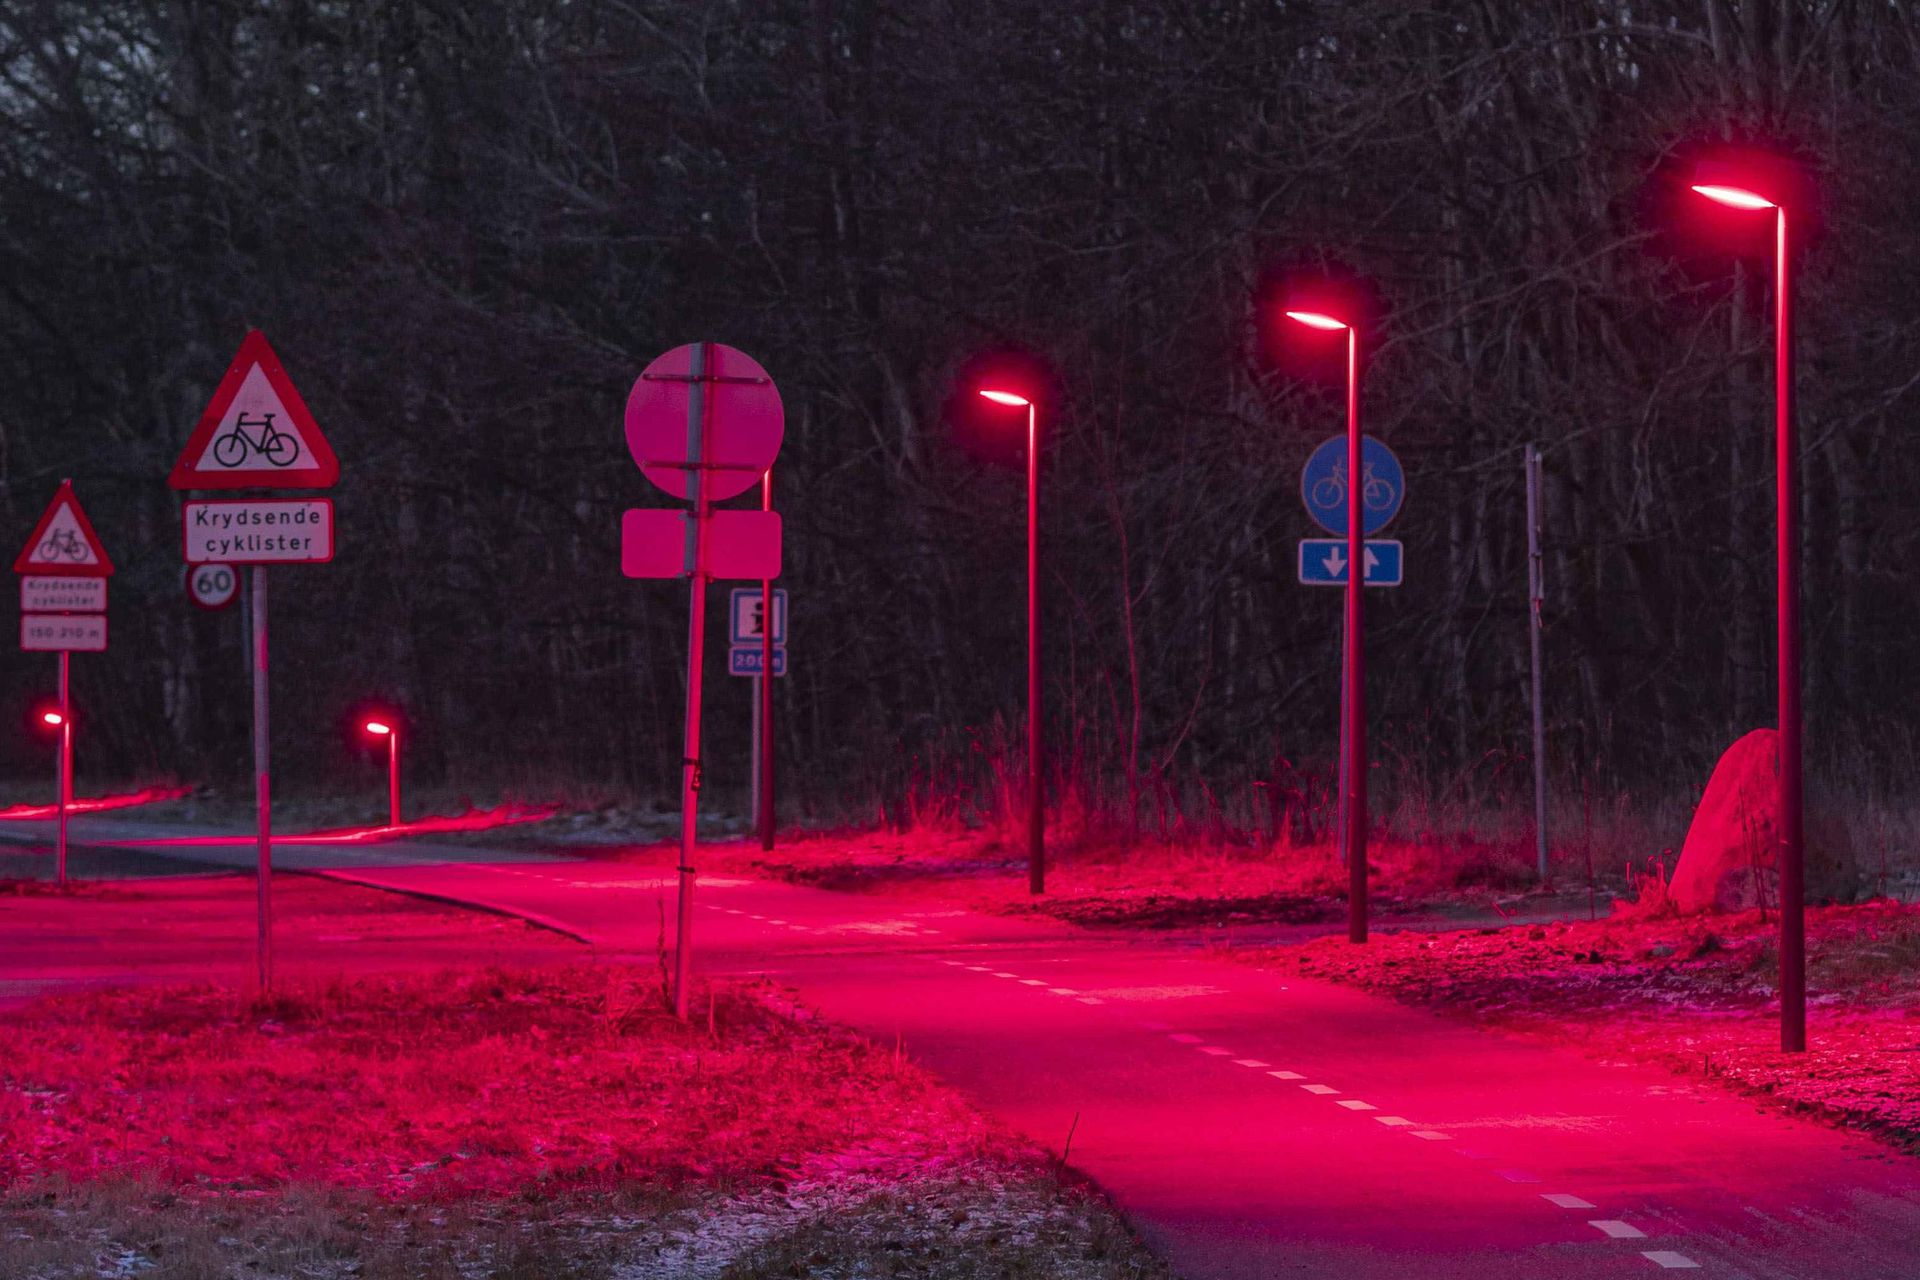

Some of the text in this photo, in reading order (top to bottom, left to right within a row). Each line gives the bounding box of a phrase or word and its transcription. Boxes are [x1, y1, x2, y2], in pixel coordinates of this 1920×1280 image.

[196, 508, 321, 529] Krydsende
[206, 535, 312, 555] cyklister
[197, 570, 231, 594] 60
